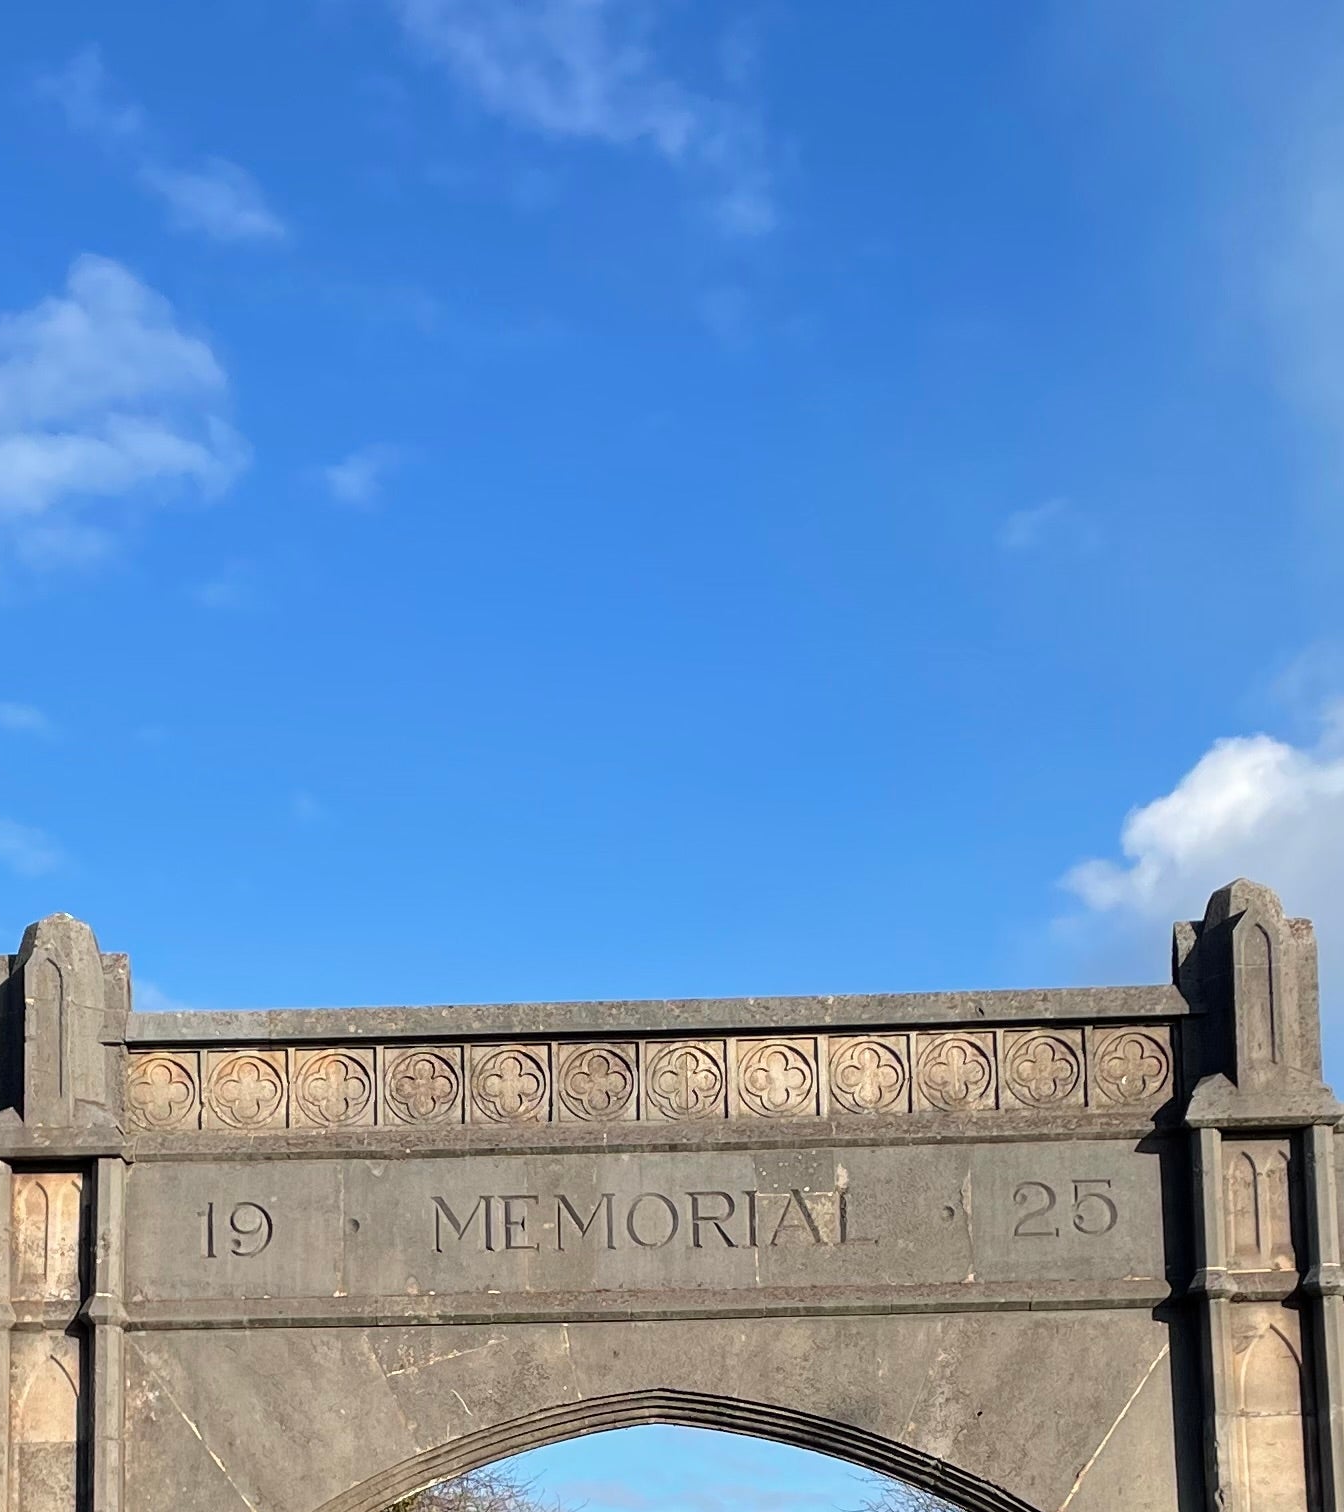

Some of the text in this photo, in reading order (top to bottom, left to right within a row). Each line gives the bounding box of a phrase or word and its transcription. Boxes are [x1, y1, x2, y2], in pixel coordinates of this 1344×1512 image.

[197, 1179, 1118, 1259] 19 MEMORIAL 25
